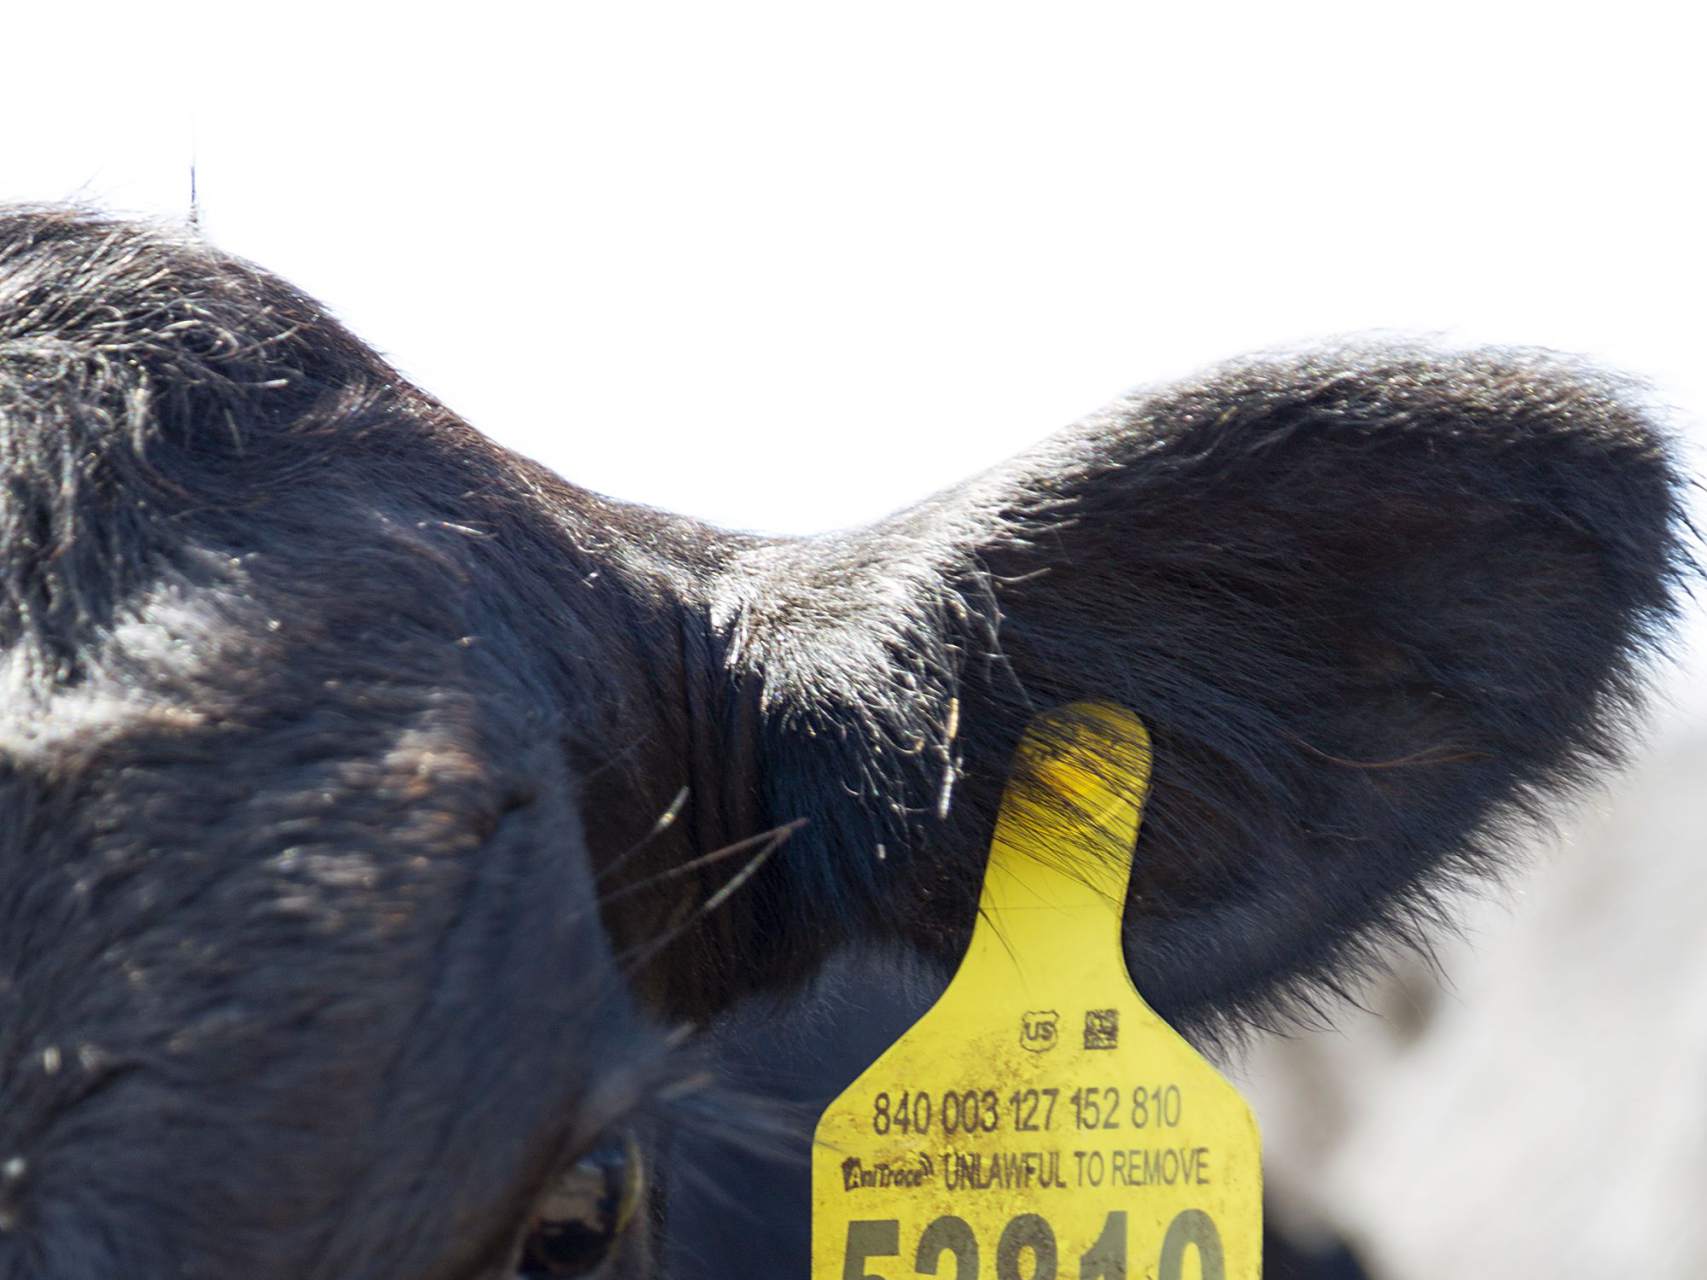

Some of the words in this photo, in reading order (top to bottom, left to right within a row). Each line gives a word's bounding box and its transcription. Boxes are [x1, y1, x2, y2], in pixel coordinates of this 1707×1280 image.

[1024, 1020, 1055, 1041] US
[873, 1090, 931, 1134] 840
[941, 1090, 998, 1134] 003
[1010, 1088, 1059, 1132] 127
[1071, 1087, 1120, 1130] 152
[1132, 1084, 1181, 1128] 810
[944, 1151, 1066, 1190] UNLAWFUL
[1074, 1151, 1102, 1187] TO
[1112, 1148, 1210, 1187] REMOVE
